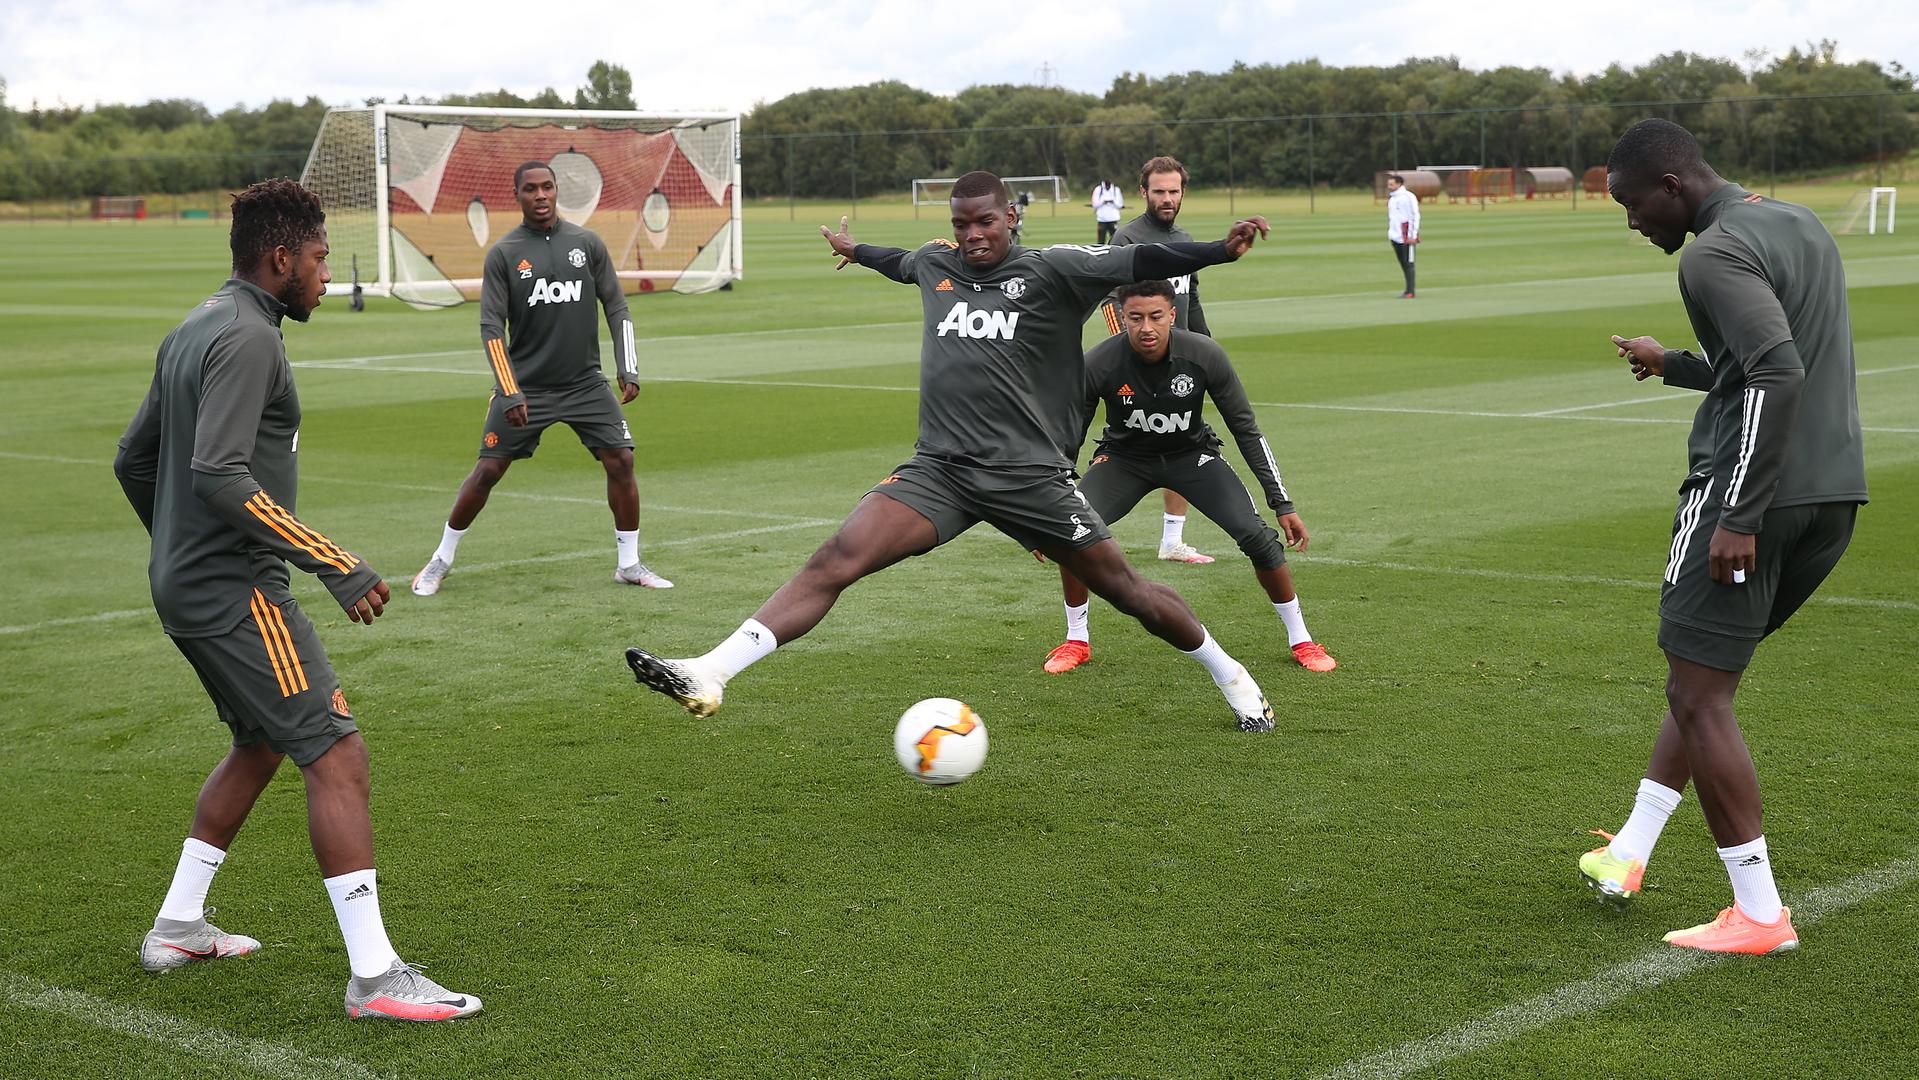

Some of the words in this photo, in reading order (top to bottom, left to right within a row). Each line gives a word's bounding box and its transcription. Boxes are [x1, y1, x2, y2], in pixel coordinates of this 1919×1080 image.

[519, 269, 533, 279] 25
[973, 283, 982, 292] 6
[1167, 274, 1191, 294] ON
[527, 278, 582, 307] AON
[937, 302, 1019, 340] AON
[1122, 396, 1133, 406] 14
[1123, 409, 1192, 434] AON
[1070, 513, 1082, 525] 6
[344, 890, 373, 902] adidas
